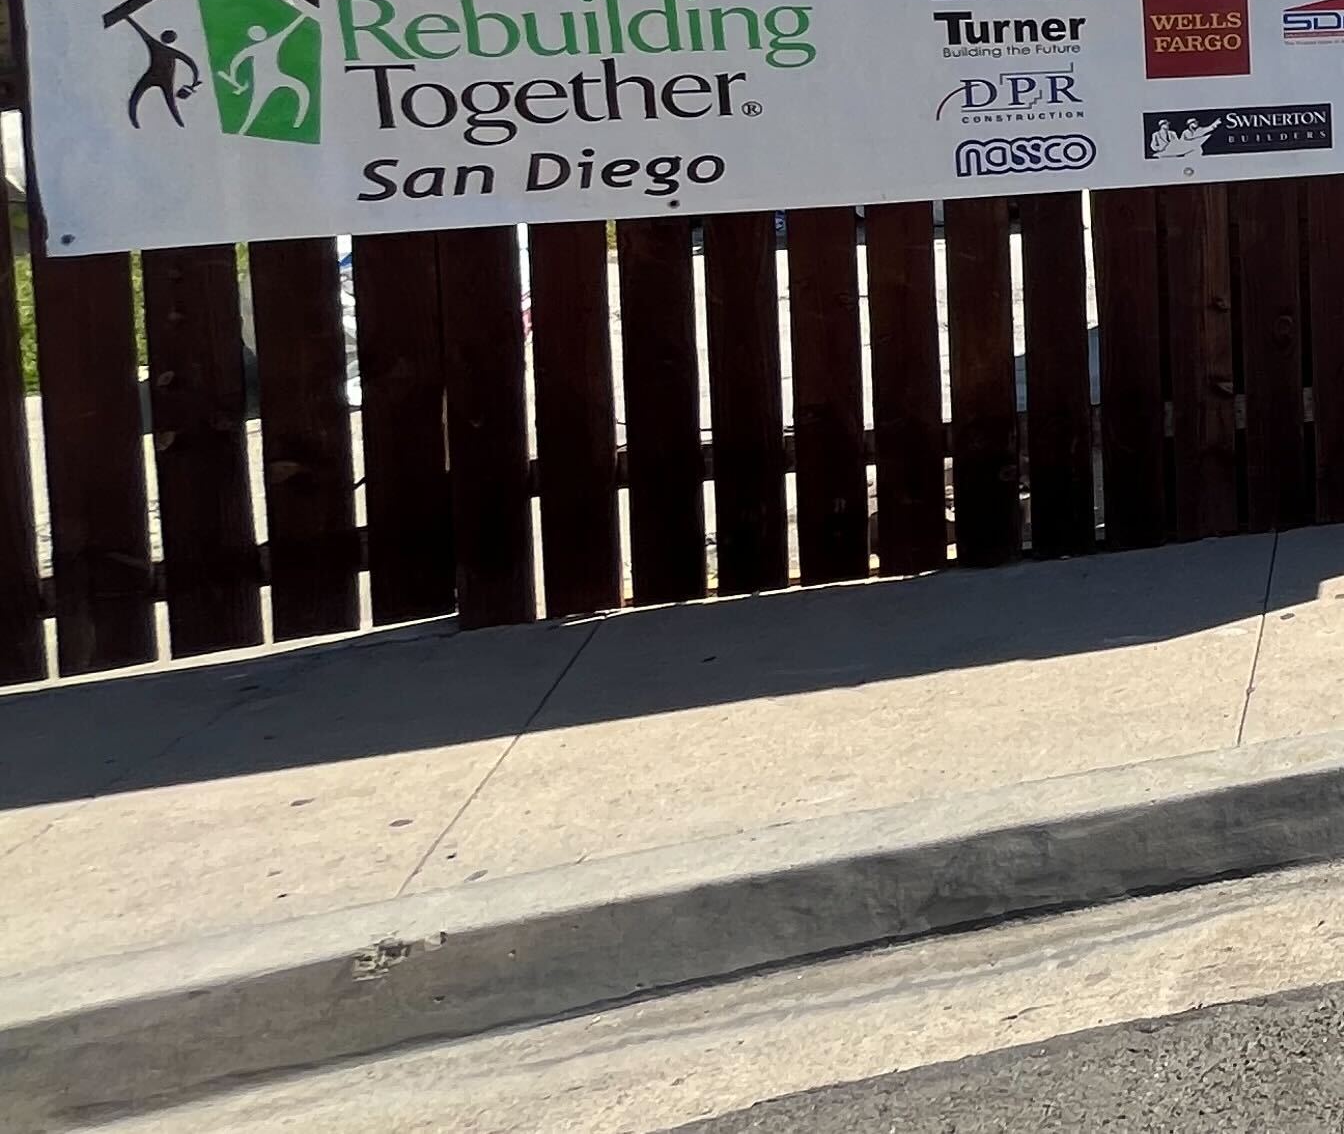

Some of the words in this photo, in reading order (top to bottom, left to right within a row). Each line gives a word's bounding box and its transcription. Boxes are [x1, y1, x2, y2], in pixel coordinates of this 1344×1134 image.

[933, 11, 1087, 46] Turner
[1150, 11, 1242, 31] WELLS
[942, 46, 1001, 59] Building
[1006, 45, 1031, 56] the
[1035, 43, 1081, 55] Future
[1153, 33, 1242, 53] FARGO
[960, 74, 1083, 108] DPR
[961, 110, 1085, 124] CONSTRUCTION
[1225, 110, 1327, 130] SWINERTON
[1228, 130, 1328, 144] BUILDERS
[955, 134, 1097, 177] nassco
[357, 159, 495, 202] San
[525, 148, 725, 196] Diego
